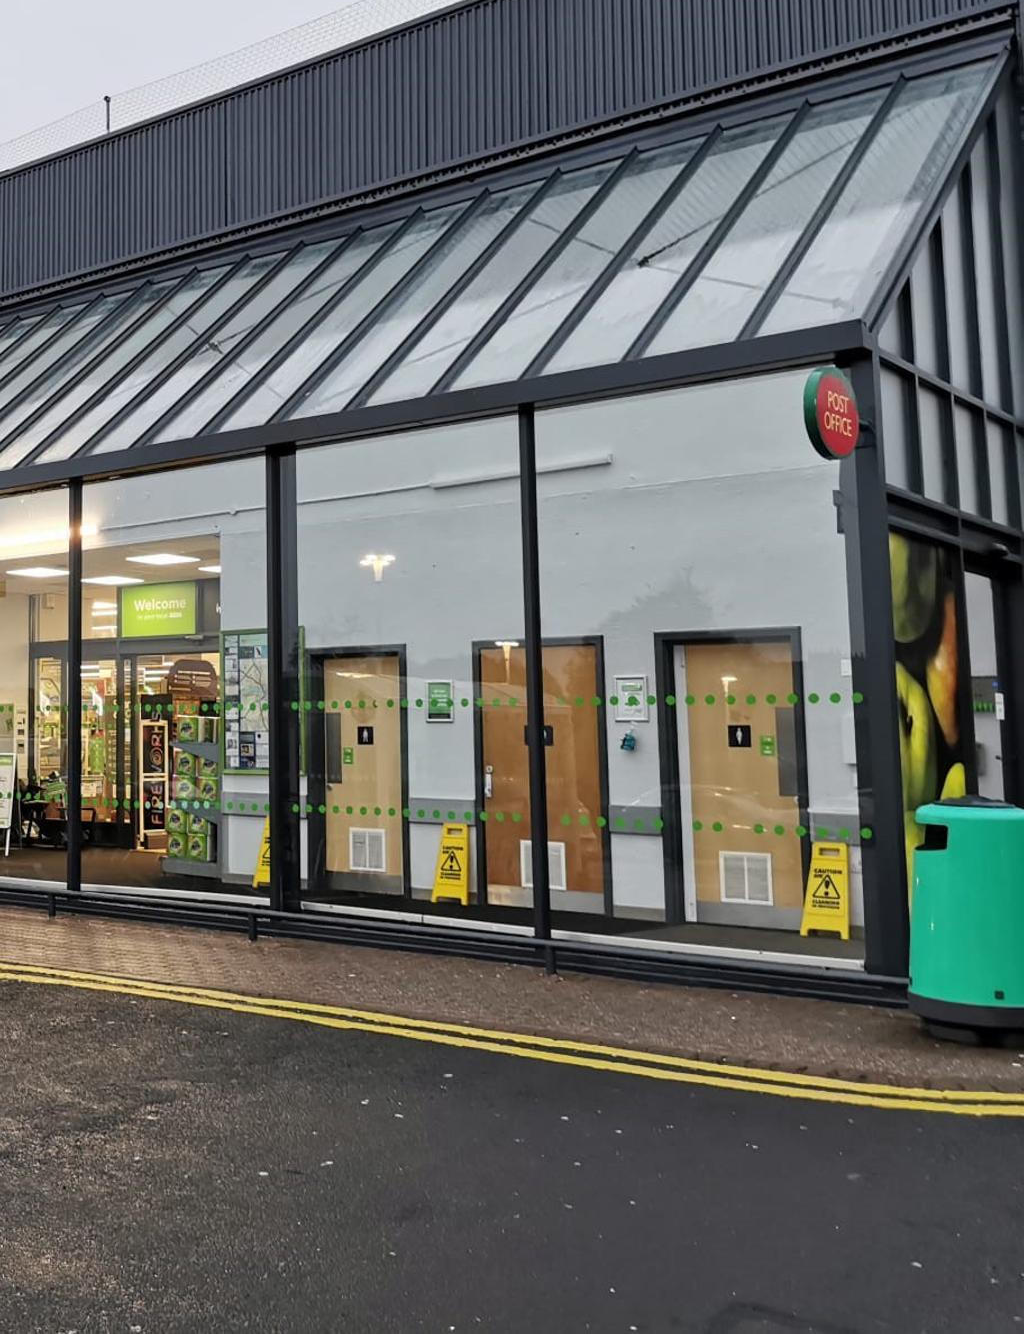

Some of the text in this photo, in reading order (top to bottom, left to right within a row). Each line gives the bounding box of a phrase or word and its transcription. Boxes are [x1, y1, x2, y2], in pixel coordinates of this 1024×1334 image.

[828, 390, 849, 414] POST
[824, 411, 852, 437] OFFICE
[134, 598, 186, 612] Welcome
